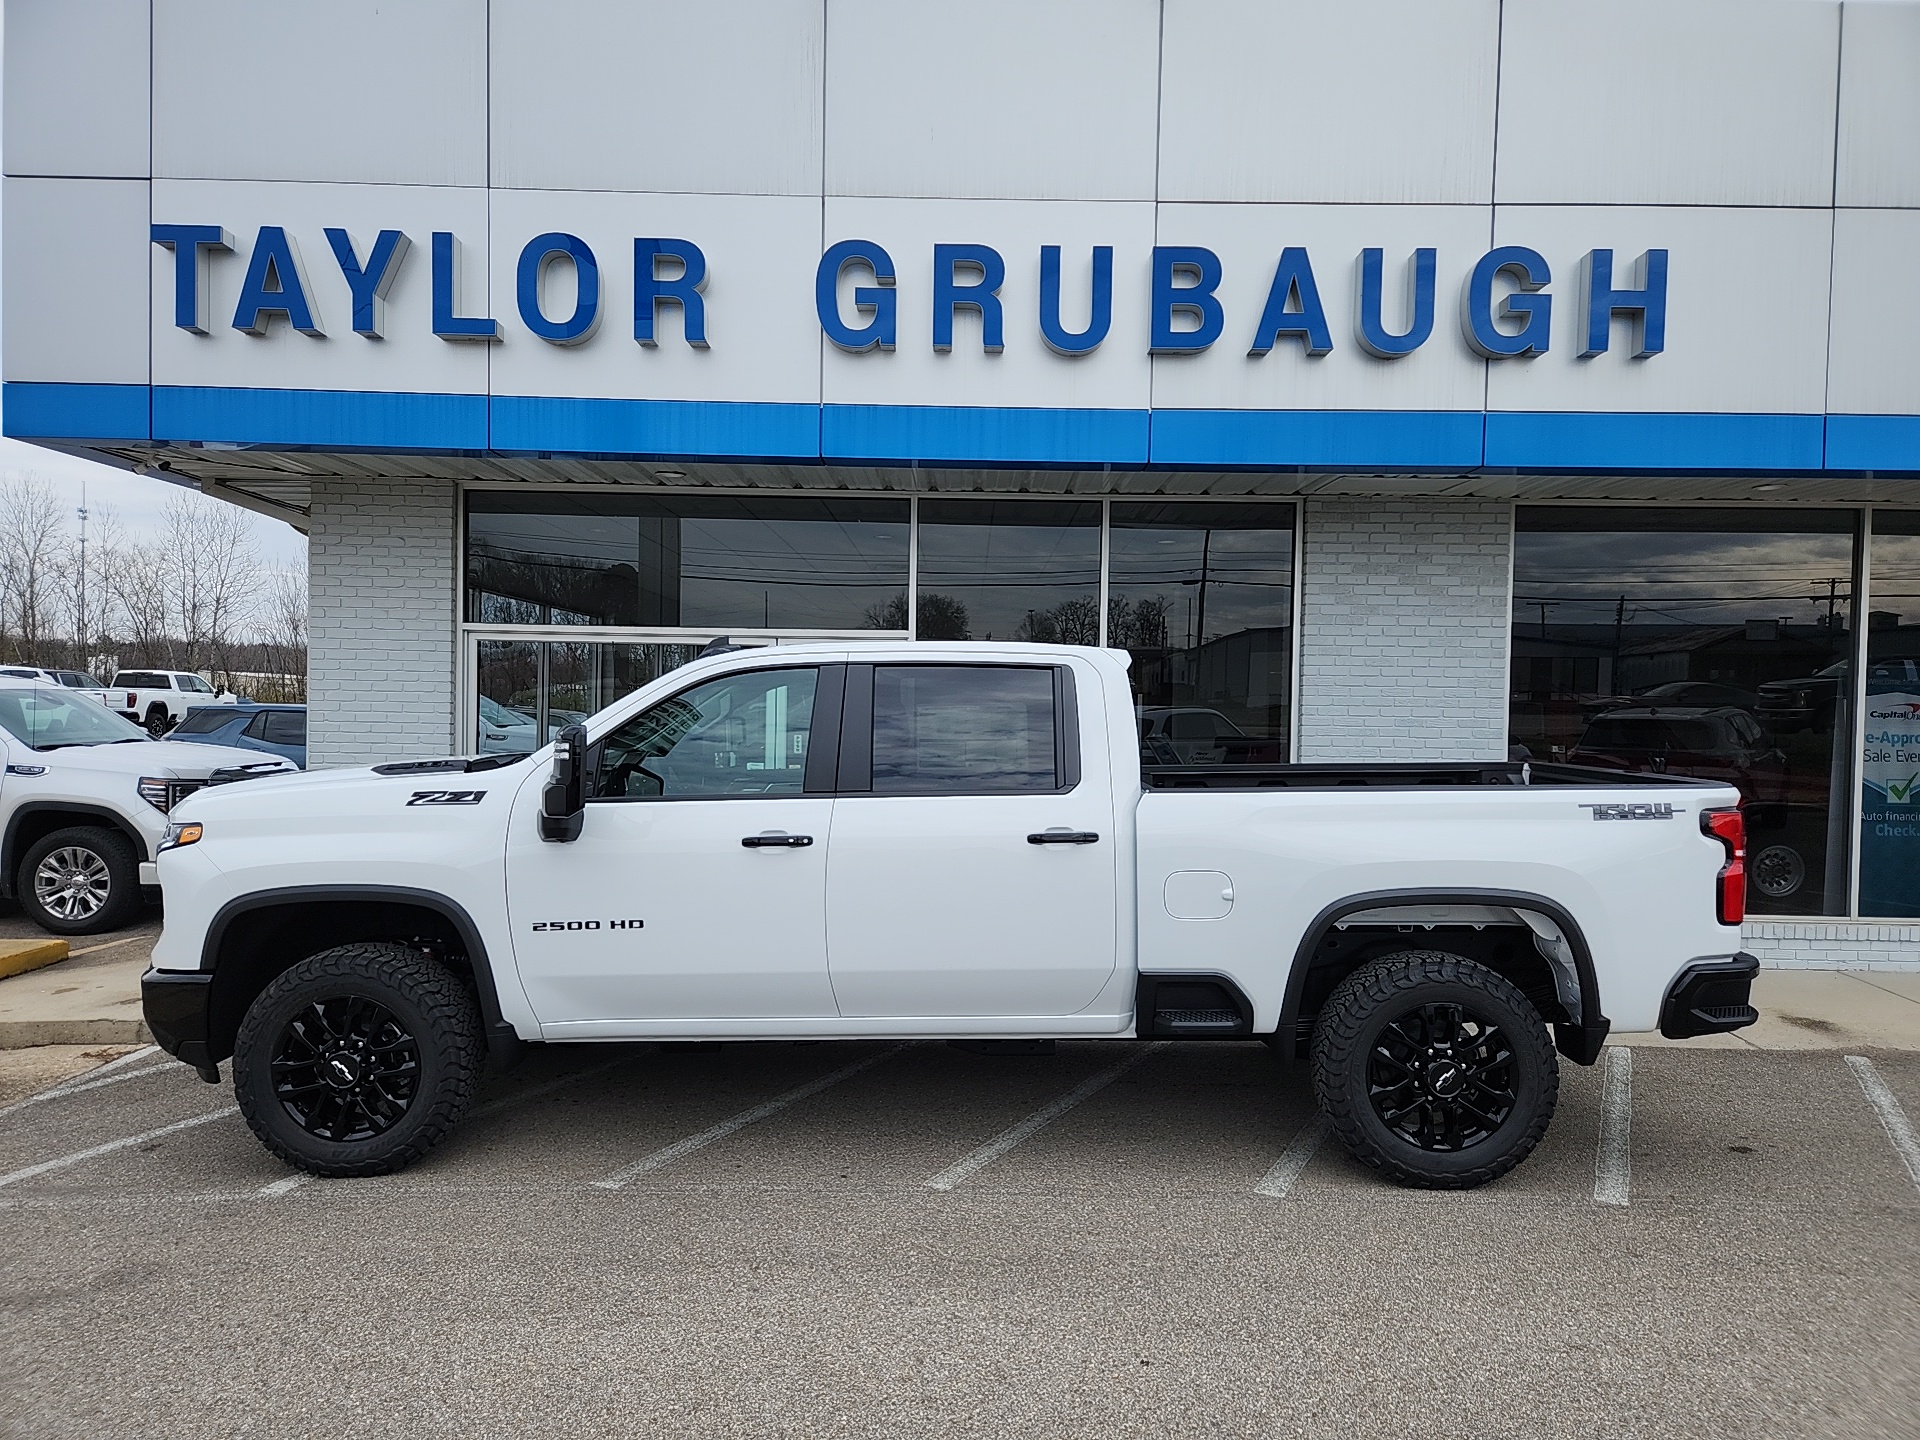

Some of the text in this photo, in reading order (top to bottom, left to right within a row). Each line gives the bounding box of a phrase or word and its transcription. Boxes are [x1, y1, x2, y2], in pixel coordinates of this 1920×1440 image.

[151, 224, 1668, 358] TAYLOR GRUBAUGH
[1863, 748, 1920, 763] Sale Eve
[405, 790, 488, 806] Z71
[1861, 810, 1920, 821] Auto financi
[532, 920, 645, 932] 2500 HD
